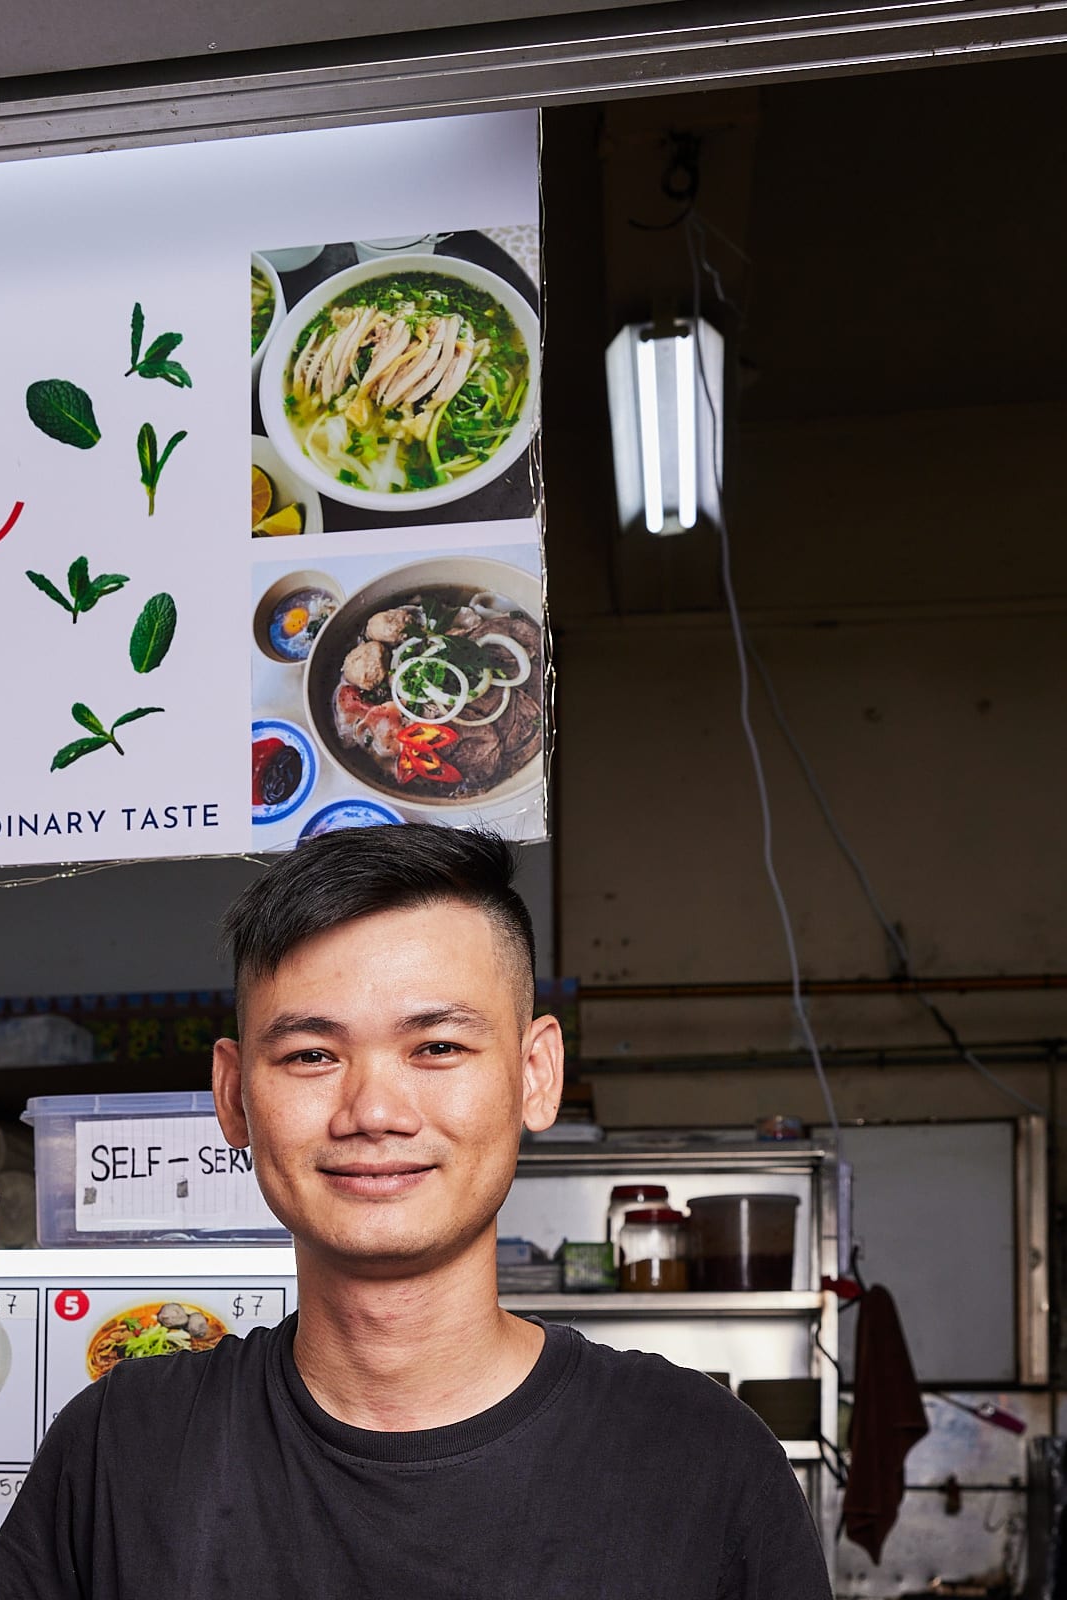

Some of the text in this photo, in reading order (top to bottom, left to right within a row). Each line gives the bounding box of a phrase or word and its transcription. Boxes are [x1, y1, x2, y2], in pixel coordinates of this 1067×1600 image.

[121, 803, 219, 831] TASTE
[91, 1144, 162, 1182] SELF
[64, 1296, 80, 1316] 5
